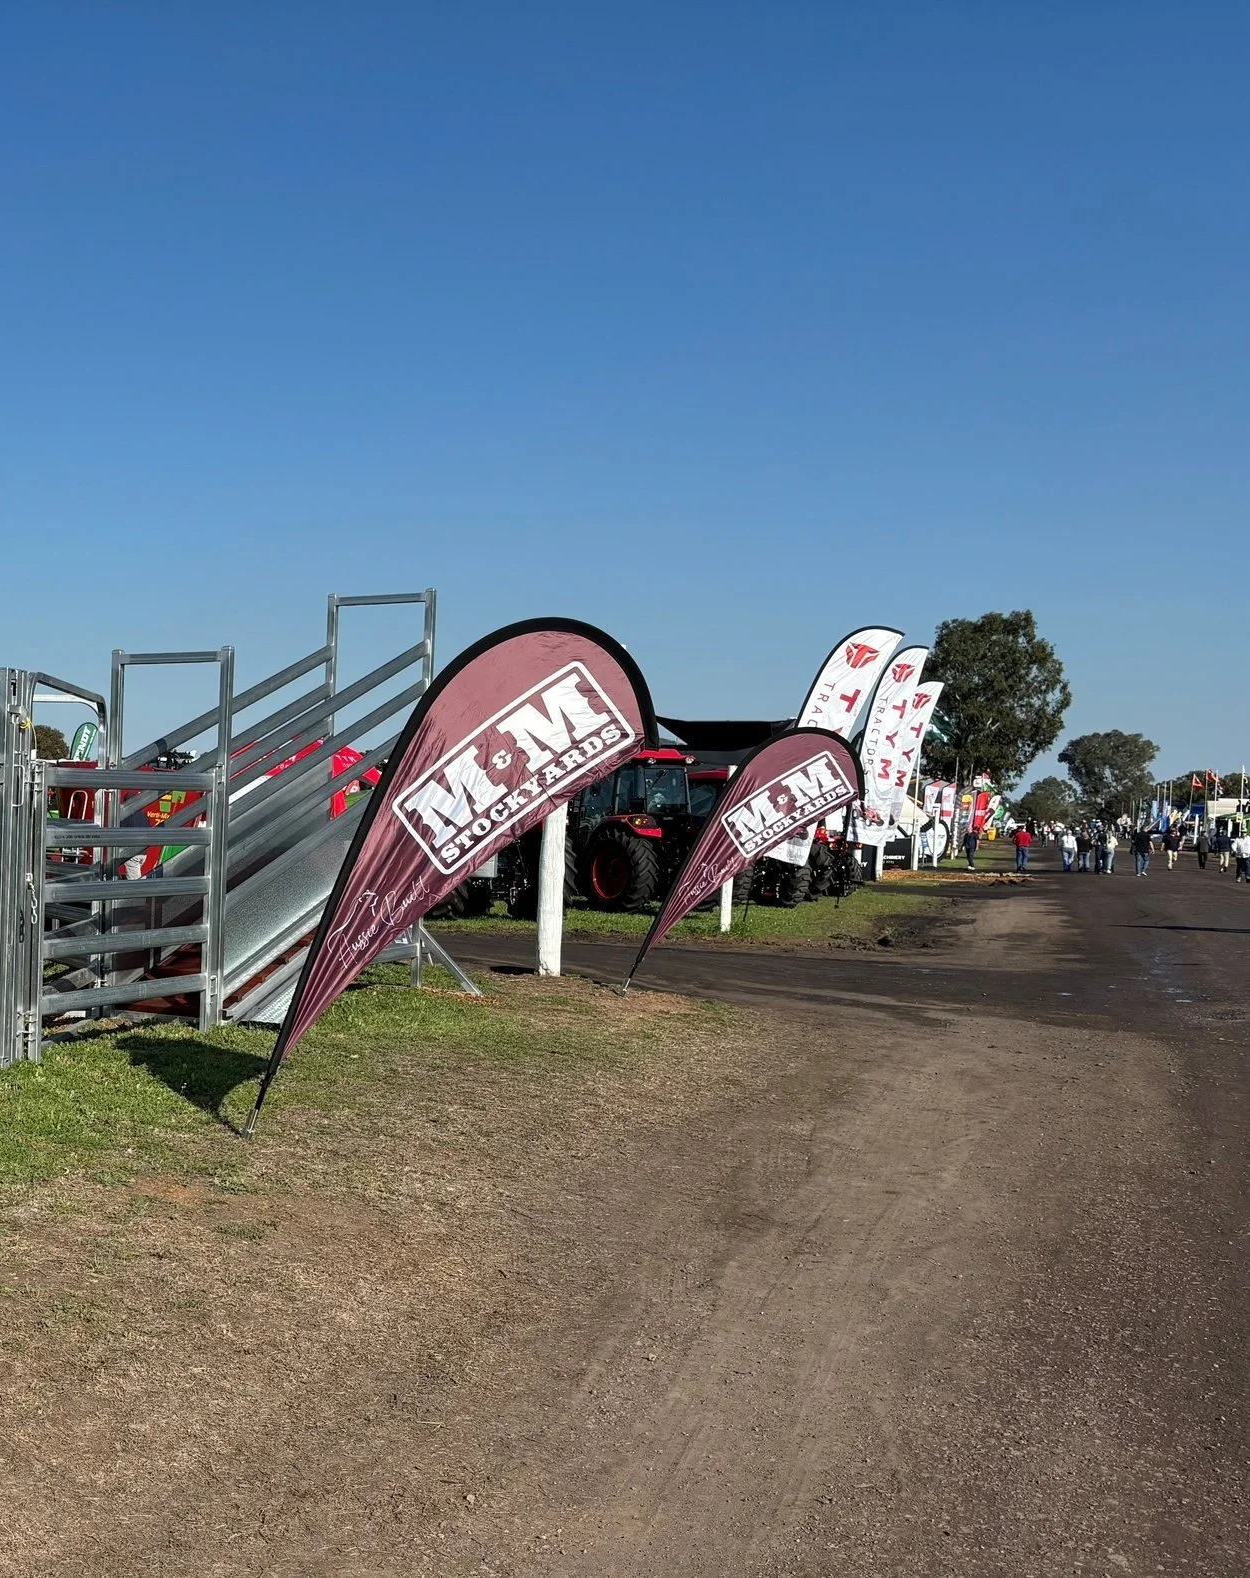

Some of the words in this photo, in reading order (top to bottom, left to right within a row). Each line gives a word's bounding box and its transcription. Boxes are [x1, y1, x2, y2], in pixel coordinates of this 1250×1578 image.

[863, 697, 889, 776] TRACTORS
[440, 724, 622, 864] STOCKYARDS
[743, 784, 848, 852] STOCKYARDS
